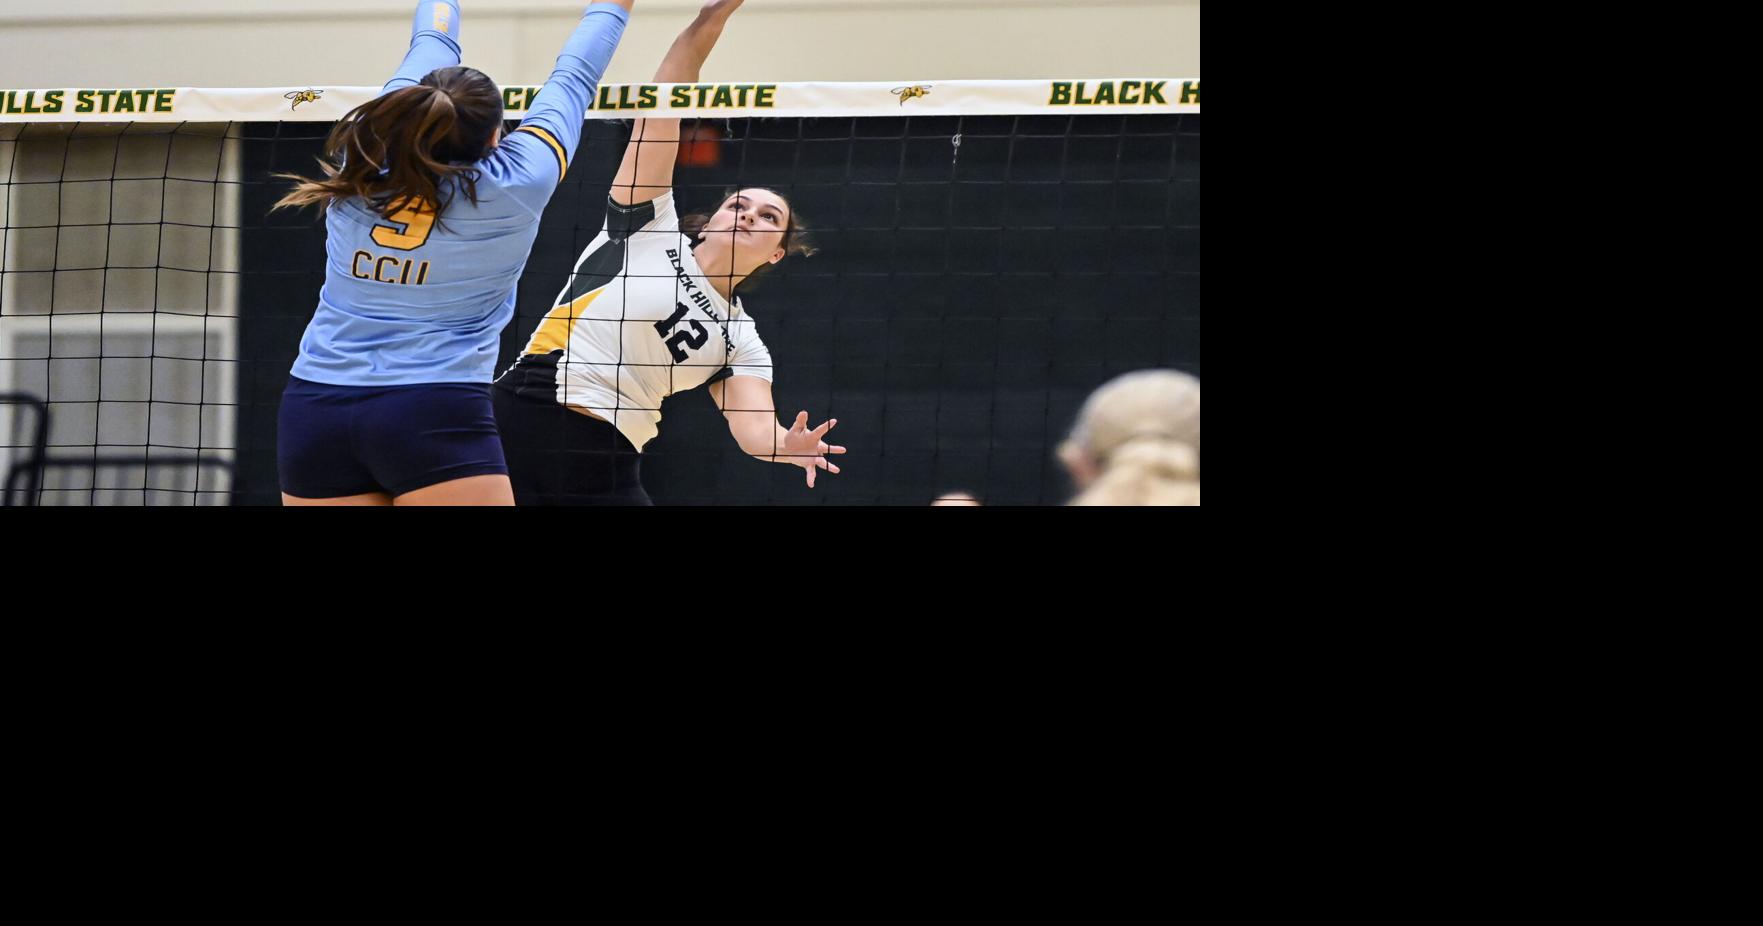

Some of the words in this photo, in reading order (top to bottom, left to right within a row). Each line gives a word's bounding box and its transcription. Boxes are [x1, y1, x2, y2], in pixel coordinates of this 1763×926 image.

[74, 89, 176, 113] STATE
[588, 85, 658, 110] LLS
[670, 84, 777, 109] STATE
[1048, 80, 1168, 105] BLACK
[665, 248, 698, 293] BLACK
[653, 301, 709, 364] 12
